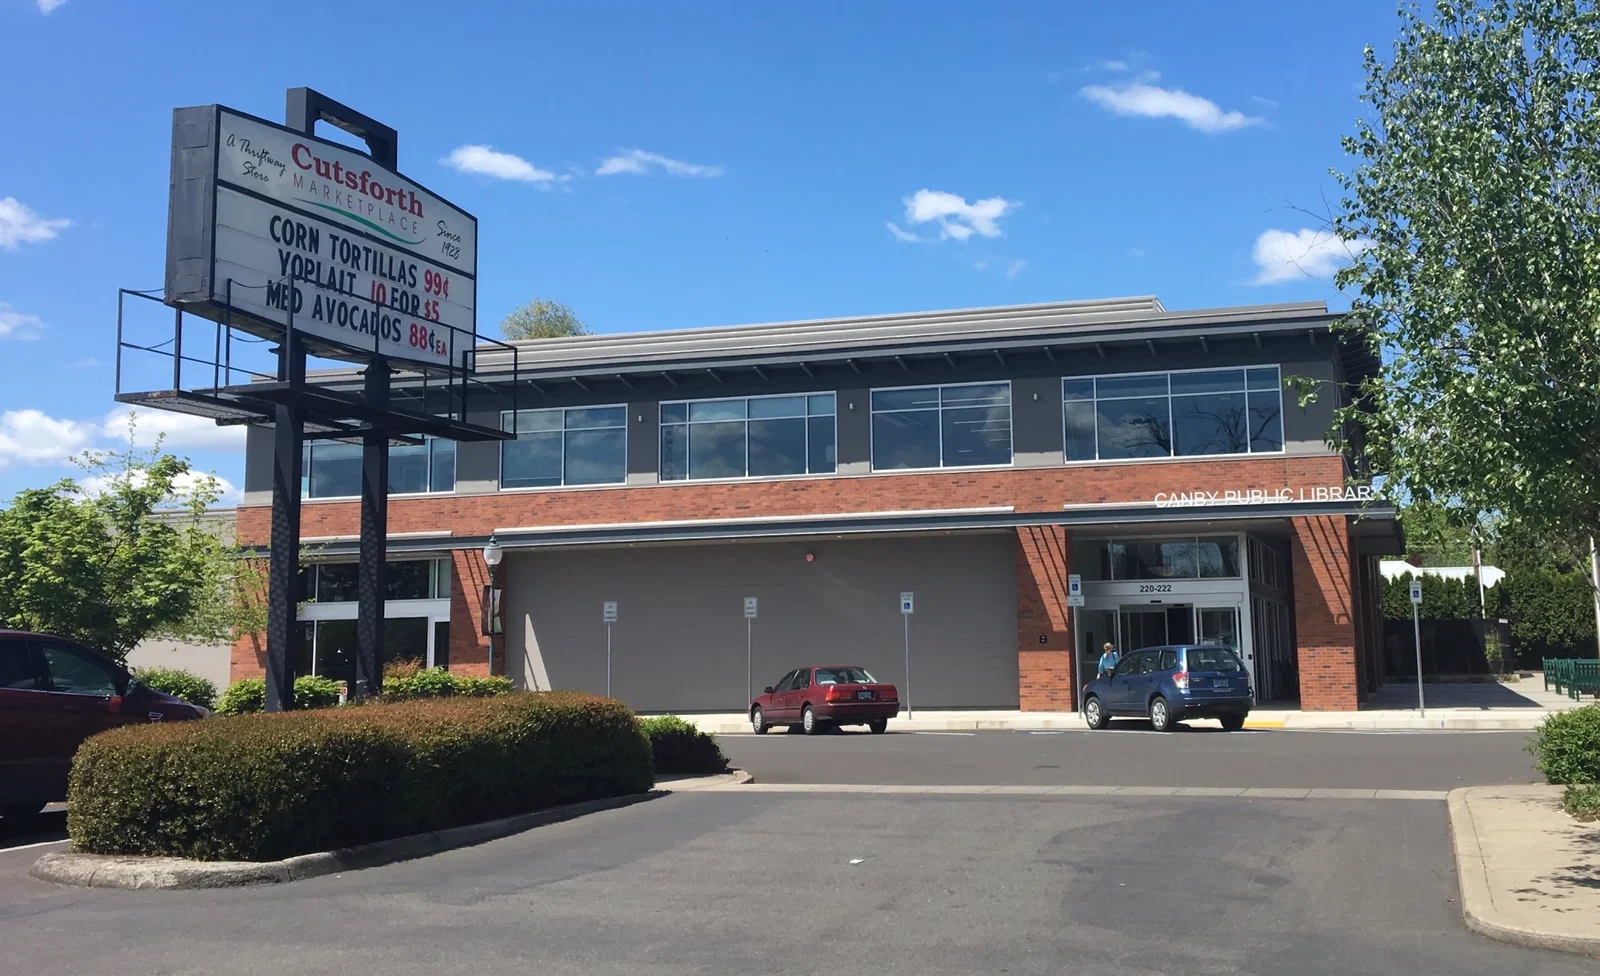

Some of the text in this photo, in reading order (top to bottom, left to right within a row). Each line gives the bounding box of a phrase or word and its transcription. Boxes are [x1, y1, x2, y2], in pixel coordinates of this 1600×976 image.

[226, 133, 287, 177] A Thriftway
[242, 160, 270, 182] Store
[291, 143, 424, 218] Cutsforth
[293, 173, 418, 235] MARKETPLACE
[436, 219, 462, 243] Since
[441, 241, 461, 260] 1928
[269, 214, 449, 299] CORN TORTILLAS 99¢
[278, 248, 440, 321] YOPLAIT 10 FOR $5
[265, 279, 303, 314] MED
[311, 294, 402, 343] AVOCADOS
[1154, 491, 1219, 507] CANBY
[1224, 488, 1294, 504] PUBLIC
[1139, 584, 1172, 593] 220-222
